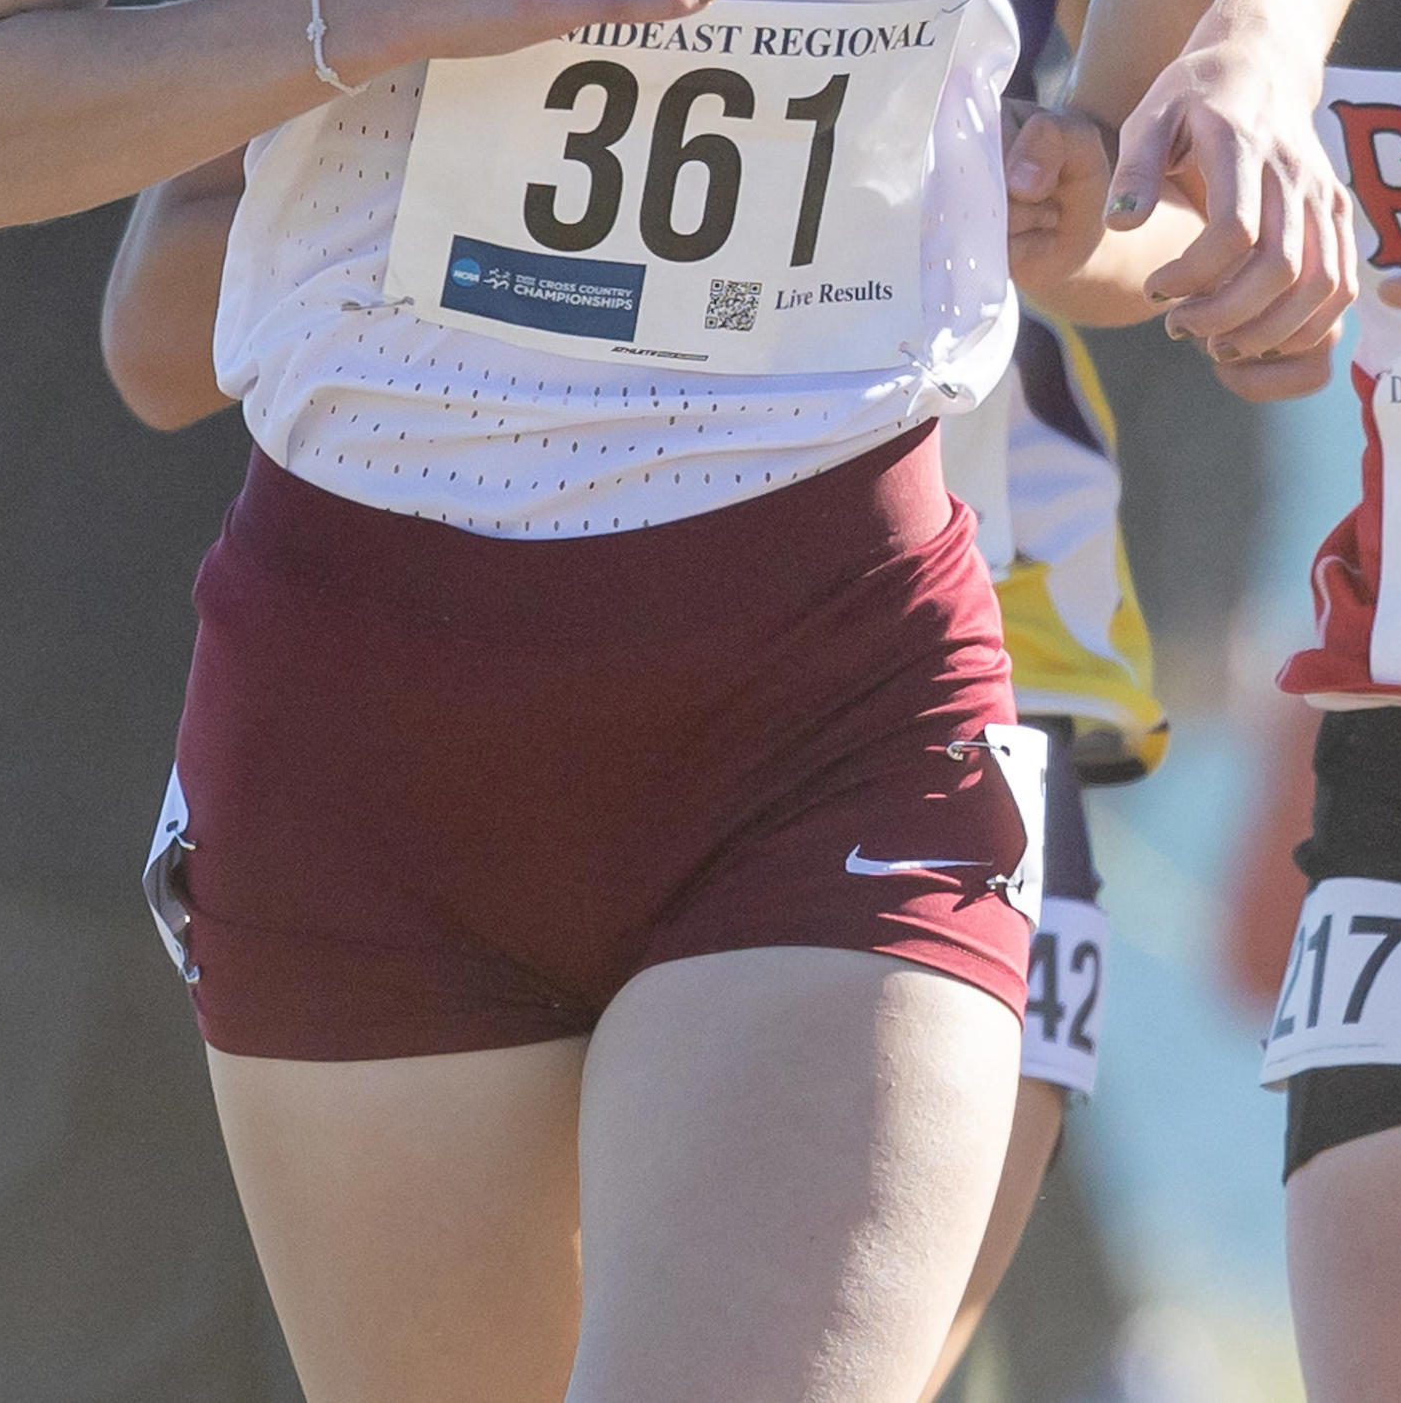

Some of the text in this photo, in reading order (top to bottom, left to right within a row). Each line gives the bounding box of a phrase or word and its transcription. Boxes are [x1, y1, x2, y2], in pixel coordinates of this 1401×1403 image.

[750, 20, 936, 58] REGIONAL
[523, 59, 850, 268] 361
[513, 284, 633, 311] CHAMPIONSHIPS
[539, 279, 577, 293] CROSS
[578, 284, 633, 298] COUNTRY
[775, 280, 893, 311] Live Results
